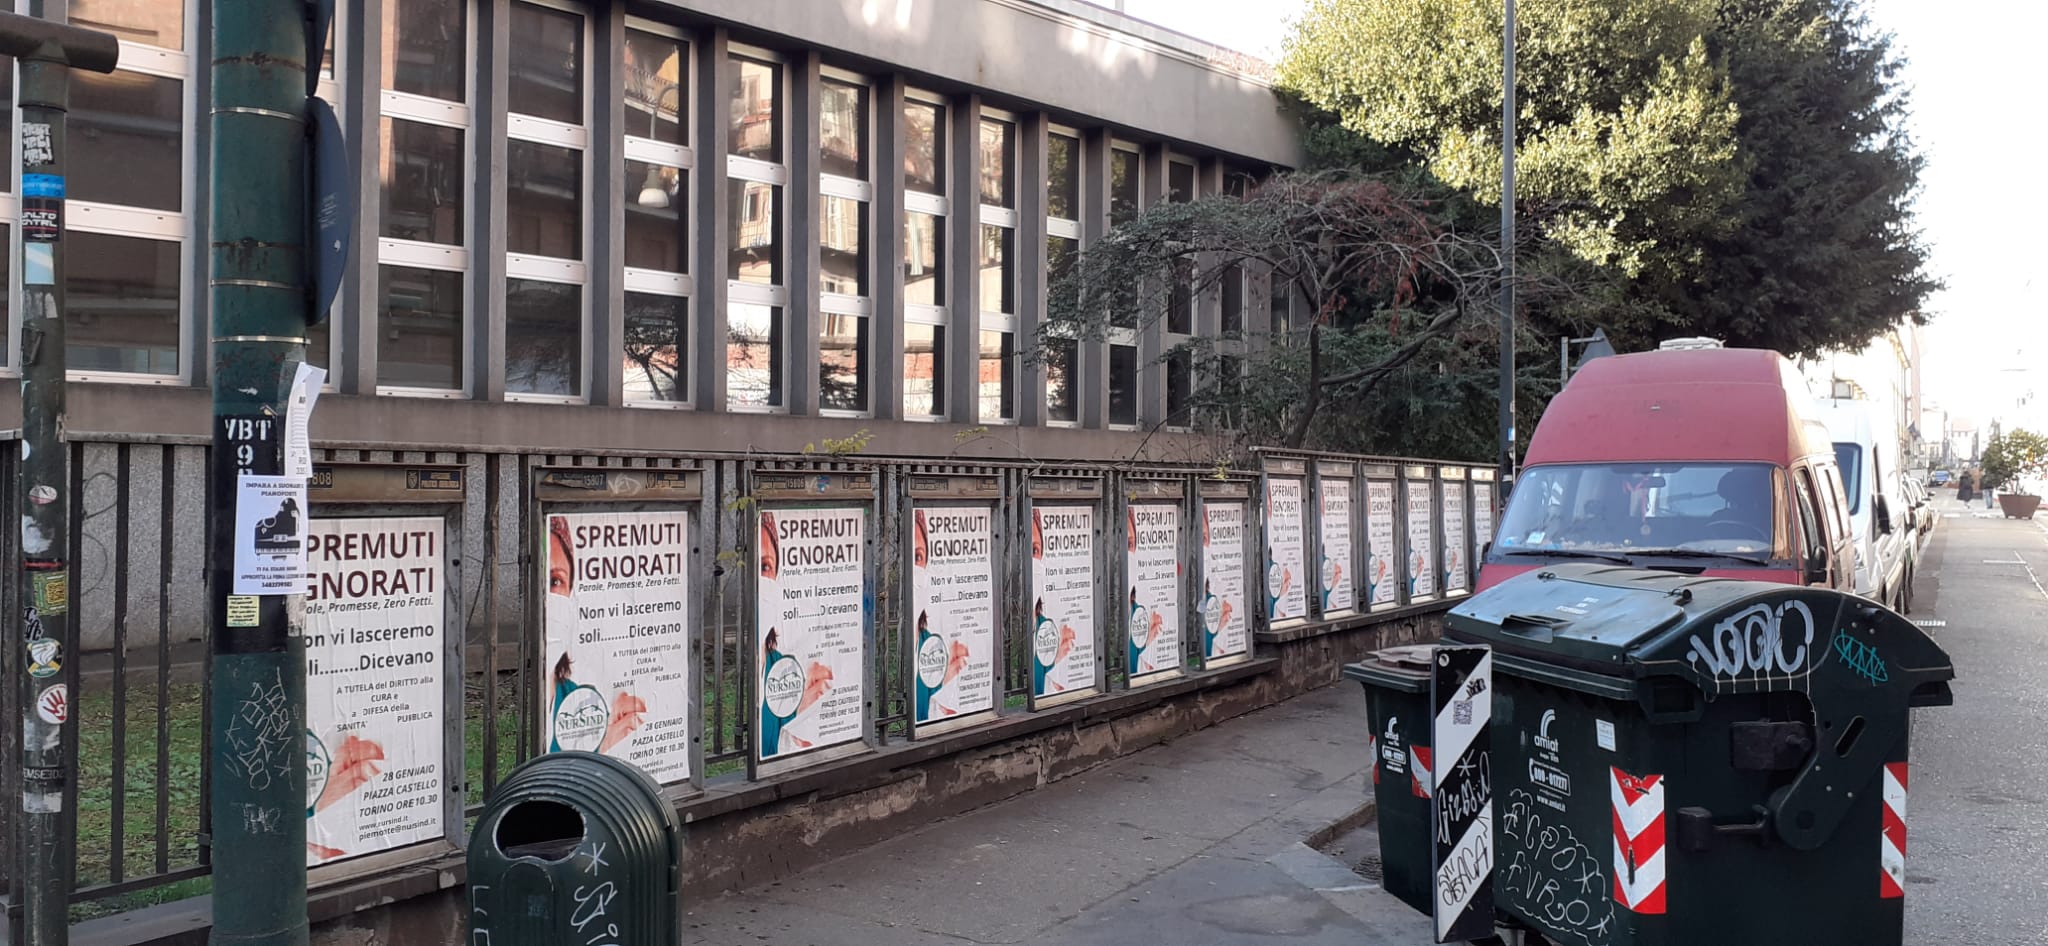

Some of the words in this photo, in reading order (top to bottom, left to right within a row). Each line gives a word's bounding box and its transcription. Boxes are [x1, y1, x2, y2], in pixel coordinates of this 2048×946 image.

[237, 445, 253, 466] 9
[928, 516, 988, 534] SPREMUTI
[1044, 514, 1090, 530] SPREMUTI
[1136, 512, 1174, 526] SPREMUTI
[576, 523, 681, 548] SPREMUTI
[780, 518, 858, 539] SPREMUTI
[1138, 530, 1174, 544] IGNORATI
[307, 532, 434, 562] PREMUTI
[930, 538, 988, 557] IGNORATI
[1044, 534, 1090, 551] IGNORATI
[782, 544, 858, 566] IGNORATI
[578, 552, 681, 581] IGNORATI
[307, 568, 434, 600] GNORATI
[646, 578, 662, 588] Zero
[783, 588, 802, 600] Non
[804, 586, 812, 598] vi
[815, 584, 858, 596] lasceremo
[306, 602, 326, 614] ole,
[328, 600, 380, 612] Promesse,
[384, 597, 406, 609] Zero
[579, 606, 604, 620] Non
[608, 602, 618, 617] vi
[622, 600, 681, 616] lasceremo
[306, 635, 325, 648] on
[330, 628, 344, 646] vi
[351, 624, 434, 644] lasceremo
[613, 650, 618, 658] A
[344, 683, 374, 693] TUTELA
[376, 682, 387, 690] del
[389, 678, 418, 688] DIRITTO
[420, 676, 434, 684] alla
[656, 673, 681, 682] PUBBLICA
[371, 693, 392, 702] CURA
[362, 706, 388, 716] DIFESA
[390, 704, 410, 712] della
[398, 712, 433, 724] PUBBLICA
[654, 717, 682, 730] GENNAIO
[632, 736, 654, 747] PIAZZA
[655, 730, 684, 742] CASTELLO
[1534, 736, 1559, 752] amiat
[630, 748, 653, 760] TORINO
[383, 771, 394, 782] 28
[396, 764, 434, 778] GENNAIO
[364, 788, 394, 800] PIAZZA
[396, 779, 438, 794] CASTELLO
[360, 802, 394, 818] TORINO
[396, 799, 414, 810] ORE
